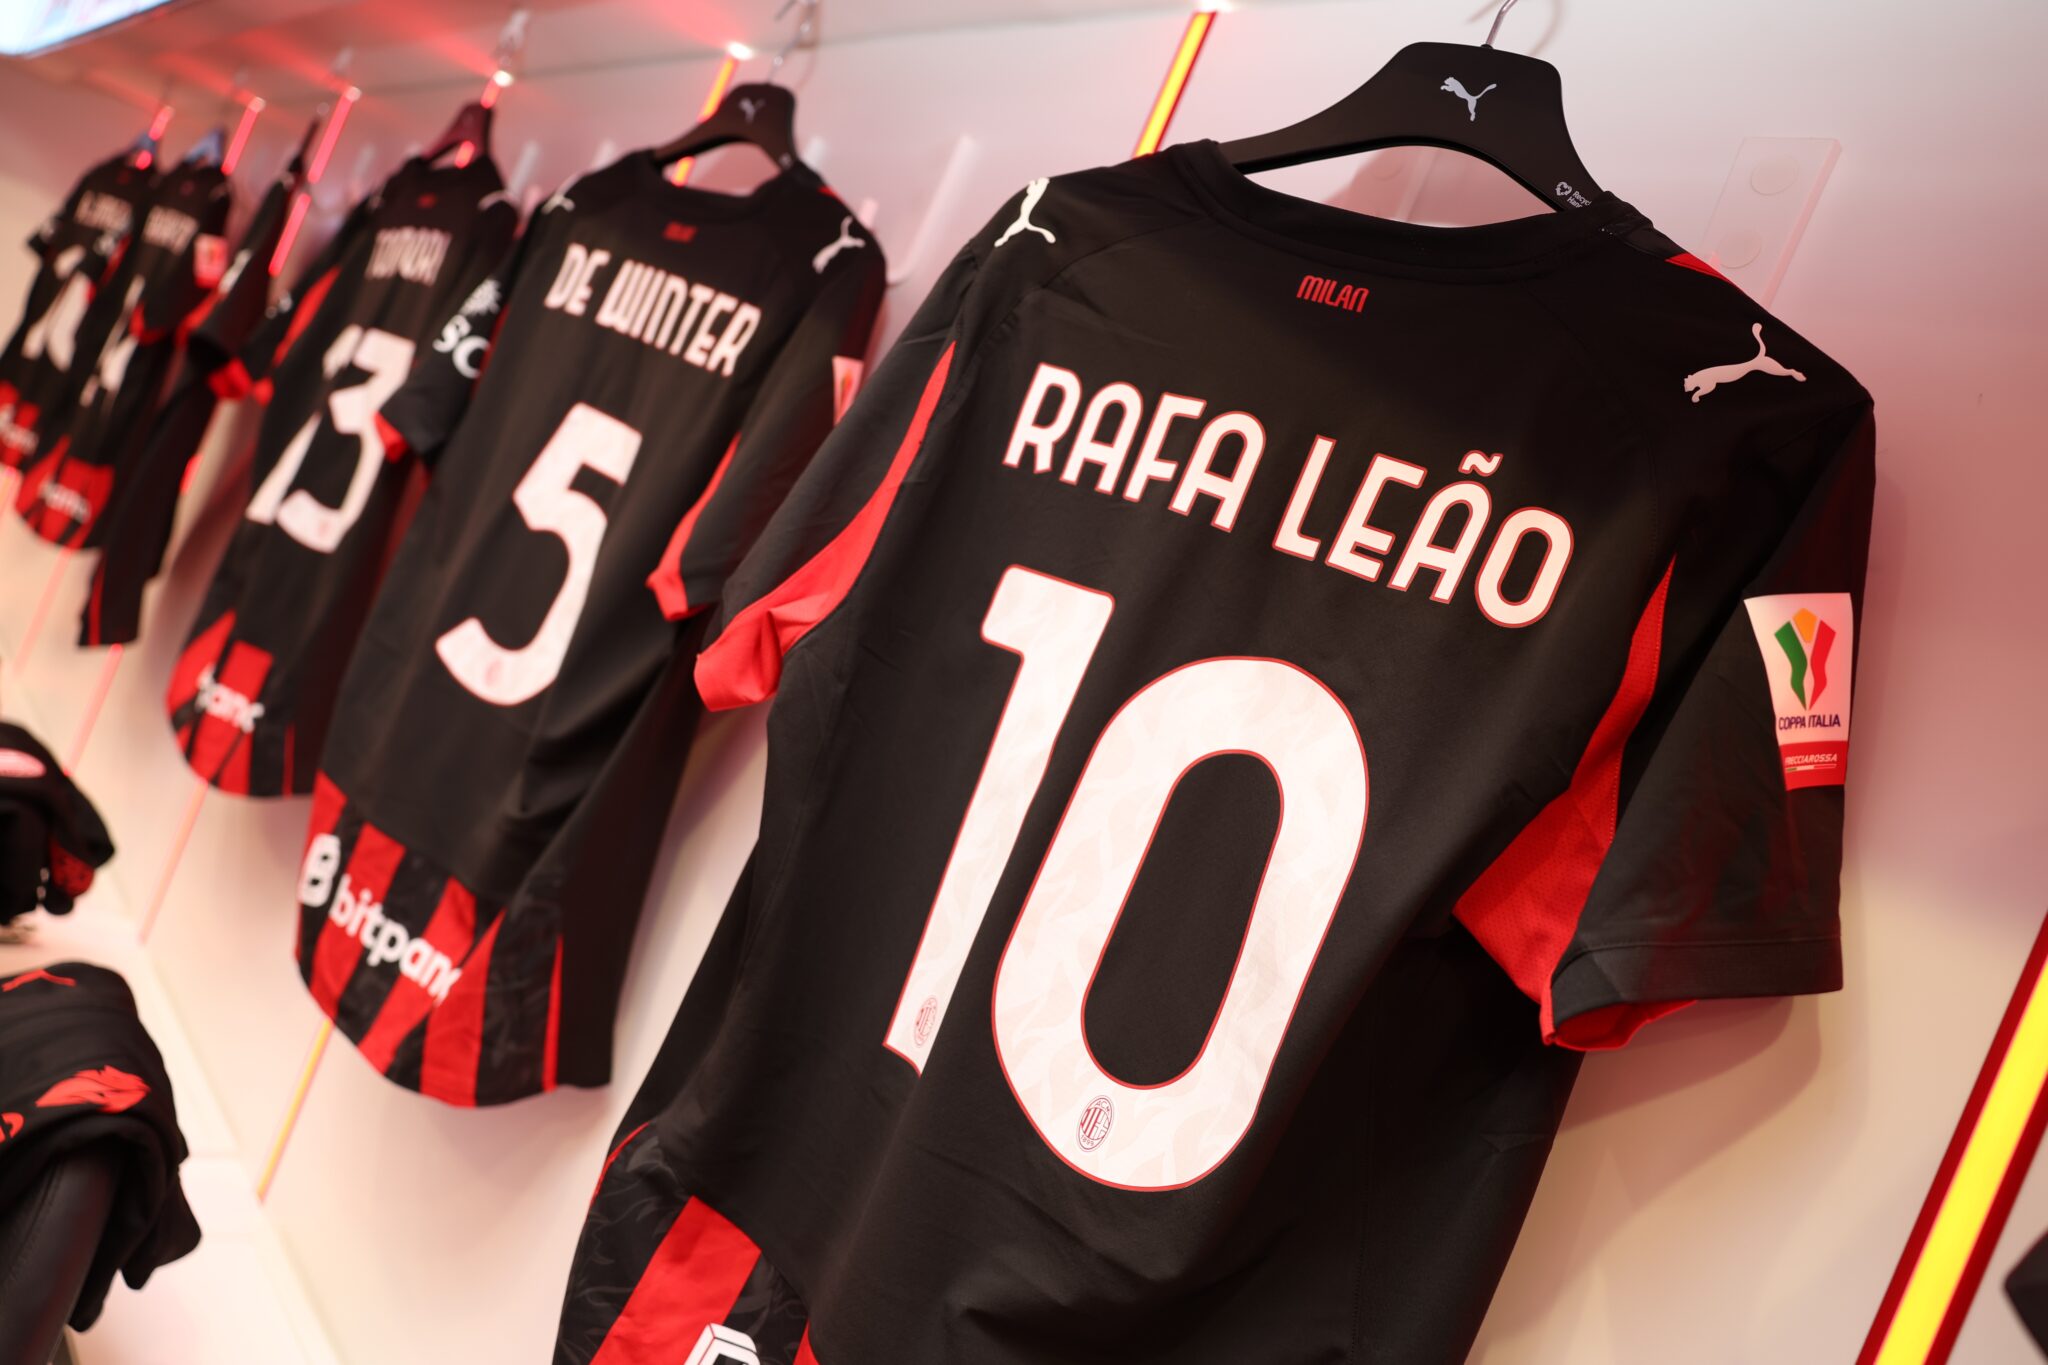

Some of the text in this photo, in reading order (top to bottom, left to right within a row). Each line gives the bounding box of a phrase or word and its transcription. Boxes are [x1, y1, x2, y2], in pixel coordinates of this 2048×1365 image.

[543, 242, 762, 378] DE WINTER
[1296, 274, 1370, 313] MILAN
[435, 401, 643, 706] 5
[1002, 362, 1574, 628] RAFA LEÃO
[1778, 714, 1841, 730] COPPA ITALIA
[329, 873, 462, 1007] bitpan
[882, 564, 1370, 1192] 10
